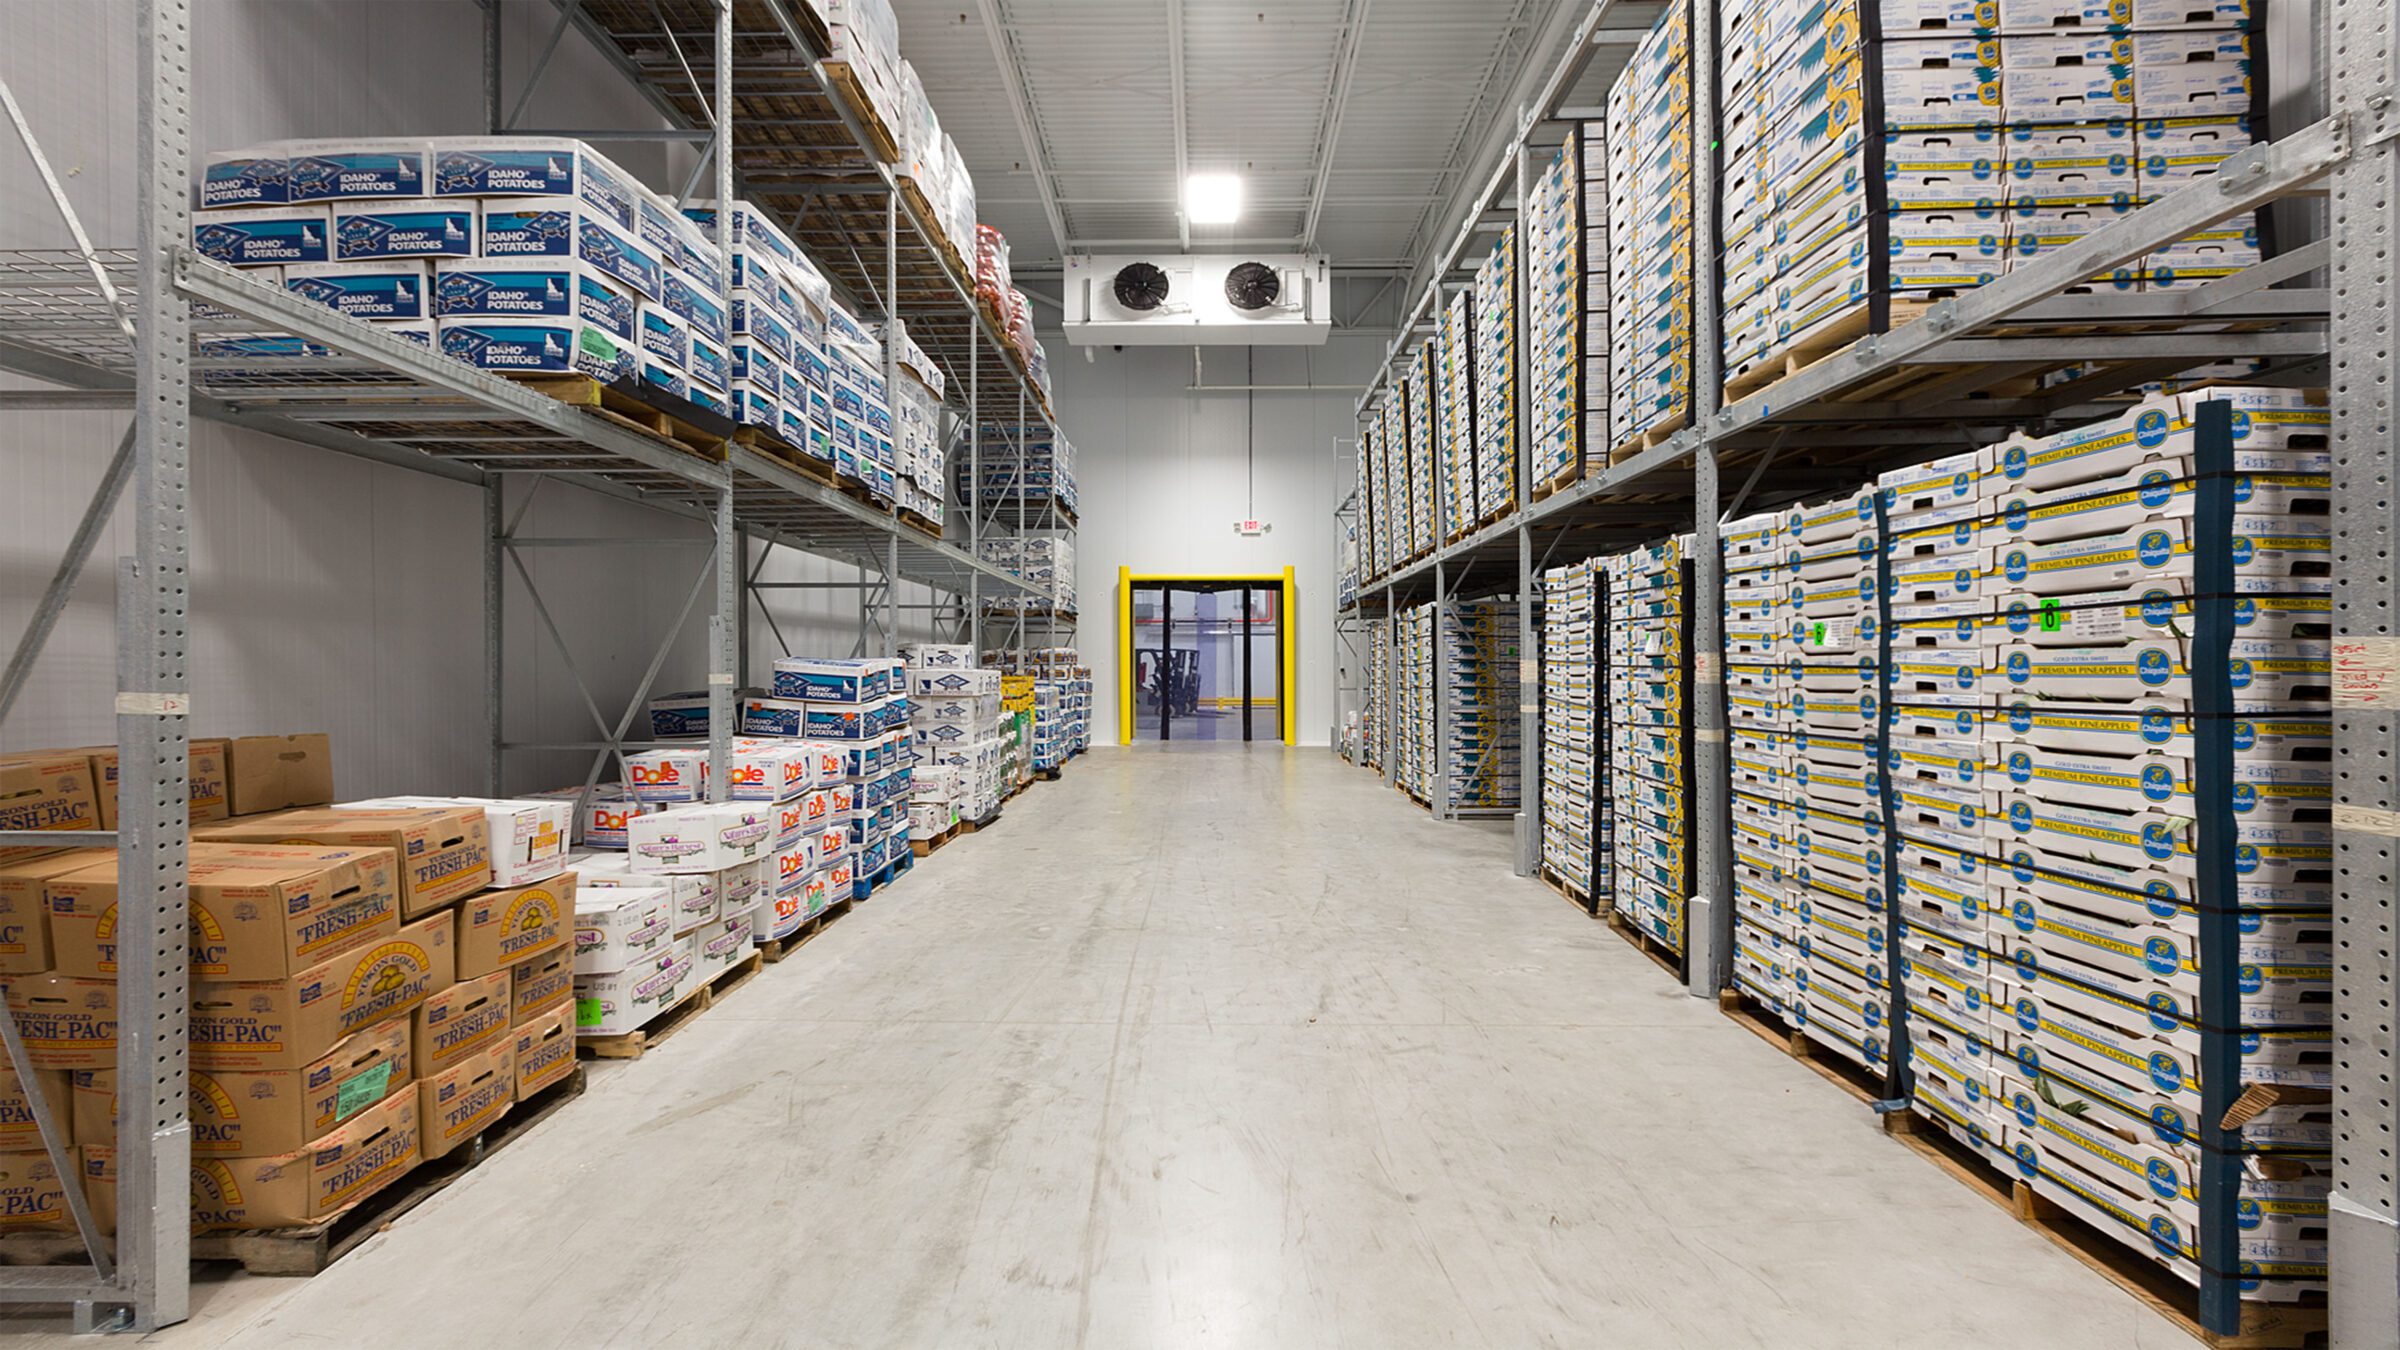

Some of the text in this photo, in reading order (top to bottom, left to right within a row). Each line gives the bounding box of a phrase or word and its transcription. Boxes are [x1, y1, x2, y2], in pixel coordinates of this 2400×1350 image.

[340, 181, 396, 192] POTATOES
[487, 179, 545, 189] POTATOES
[205, 188, 261, 202] POTATOES
[244, 248, 301, 258] POTATOES
[388, 240, 442, 250] POTATOES
[487, 241, 546, 252] POTATOES
[338, 303, 394, 313] POTATOES
[487, 300, 543, 310] POTATOES
[580, 304, 620, 331] POTATOES
[486, 354, 541, 365] POTATOES
[577, 362, 620, 382] POTATO
[2304, 413, 2331, 421] PINEA
[2034, 435, 2127, 464] PREMIUM PINEAPPLES
[2035, 493, 2129, 519] PREMIUM PINEAPPLES
[1244, 521, 1257, 530] EXIT
[2035, 552, 2128, 572] PREMIUM PINEAPPLES
[2038, 666, 2129, 675] PREMIUM PINEAPPLES
[806, 691, 841, 699] POTATOES
[807, 728, 845, 737] POTATOES
[2039, 718, 2132, 731] PREMIUM PINEAPPLES
[784, 760, 803, 781] Dole
[822, 753, 839, 772] Dole
[632, 764, 680, 784] Dole
[732, 764, 765, 783] ole
[2039, 769, 2132, 787] PREMIUM PINEAPPLES
[0, 805, 29, 817] KON
[0, 802, 89, 830] ESH-PAC"
[782, 807, 801, 829] Dole
[2040, 820, 2132, 843] PREMIUM PINEAPPLES
[823, 831, 842, 851] Dole
[780, 850, 804, 875] Dole
[2042, 921, 2135, 956] PREMIUM PINEAPPLES
[357, 955, 417, 997] YUKON GOLD
[53, 1012, 92, 1021] GOLD
[189, 1017, 257, 1025] KON GOLD
[14, 1022, 117, 1040] ESH-PAC"
[189, 1025, 281, 1042] ESH-PAC"
[2046, 1022, 2140, 1067] PREMIUM PINEAPPLES
[2043, 1119, 2138, 1173] PREMIUM PINEAPPLES
[344, 1146, 378, 1169] YUKON
